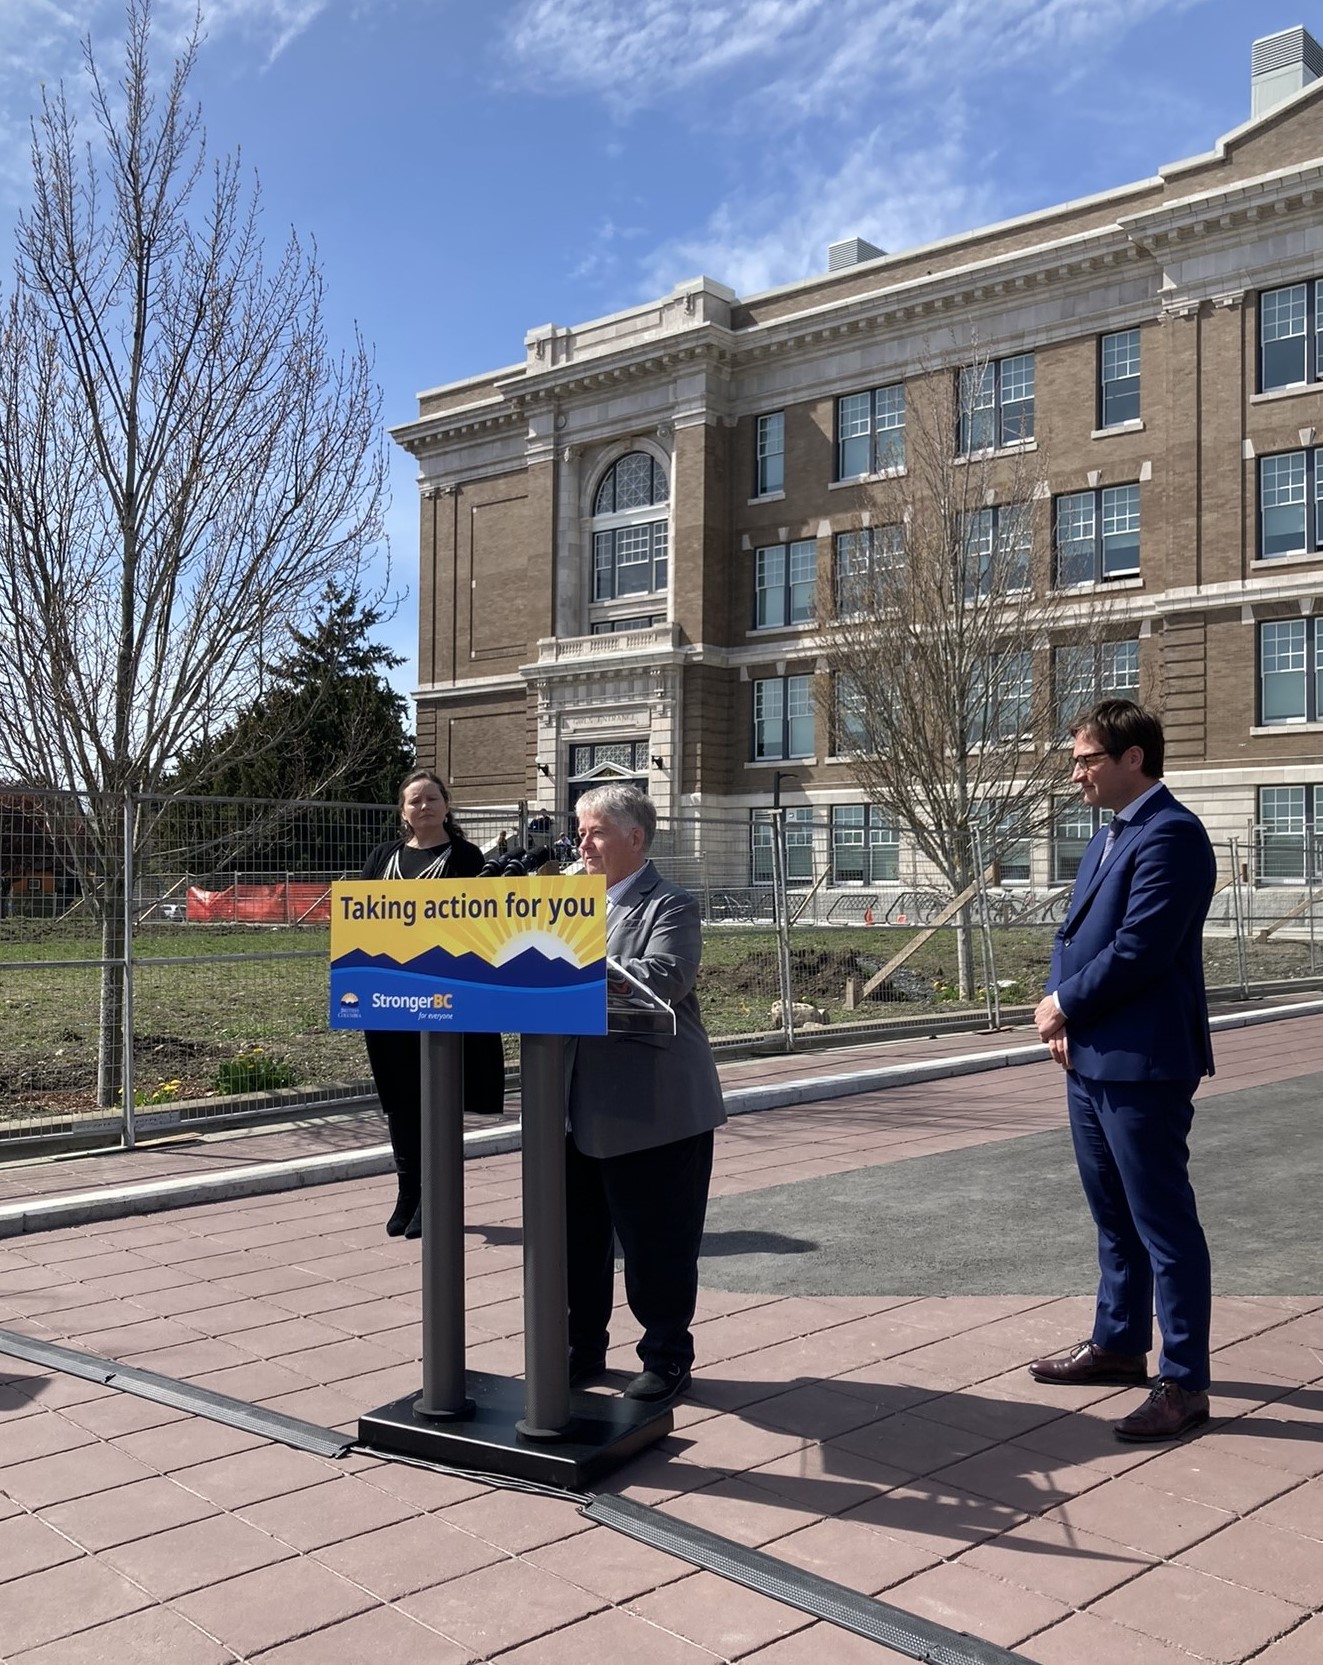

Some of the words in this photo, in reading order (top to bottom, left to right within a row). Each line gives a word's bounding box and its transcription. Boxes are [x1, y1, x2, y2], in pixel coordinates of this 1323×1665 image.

[340, 894, 417, 927] Taking
[424, 893, 498, 920] action
[505, 892, 541, 918] for
[548, 897, 595, 924] you
[372, 992, 453, 1012] StrongerBC
[418, 1012, 428, 1020] for
[428, 1013, 453, 1021] everyone
